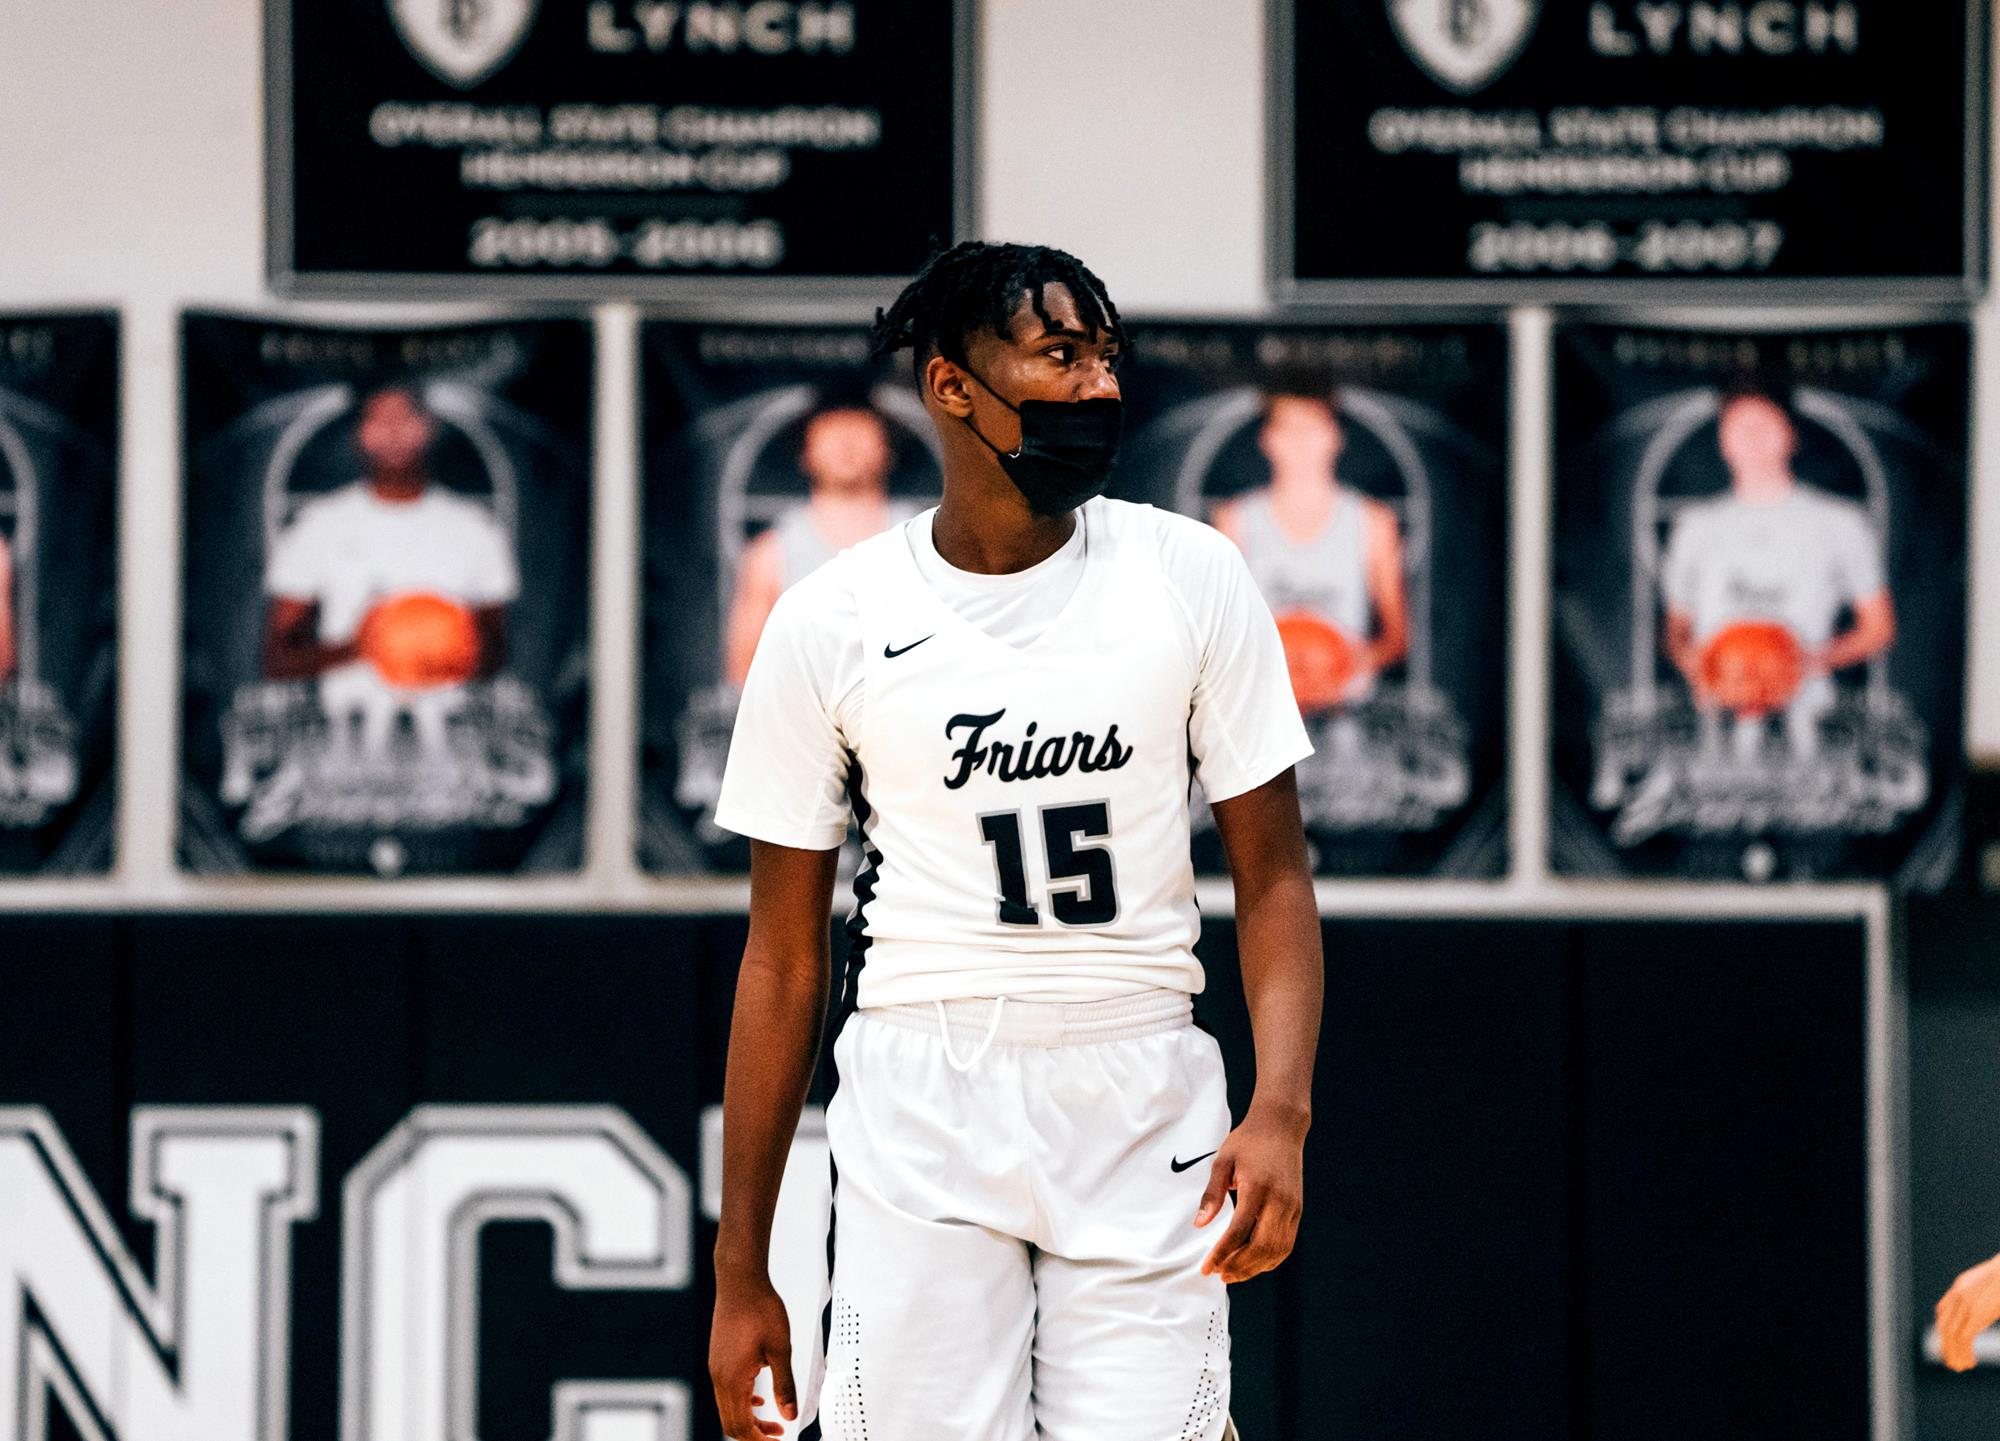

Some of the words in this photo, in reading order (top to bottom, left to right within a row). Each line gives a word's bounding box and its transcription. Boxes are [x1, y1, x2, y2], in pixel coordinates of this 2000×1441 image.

[588, 2, 854, 52] LYNCH
[1591, 3, 1857, 54] LYNCH
[944, 708, 1133, 789] Friars
[976, 798, 1121, 929] 15
[0, 1104, 842, 1441] NC
